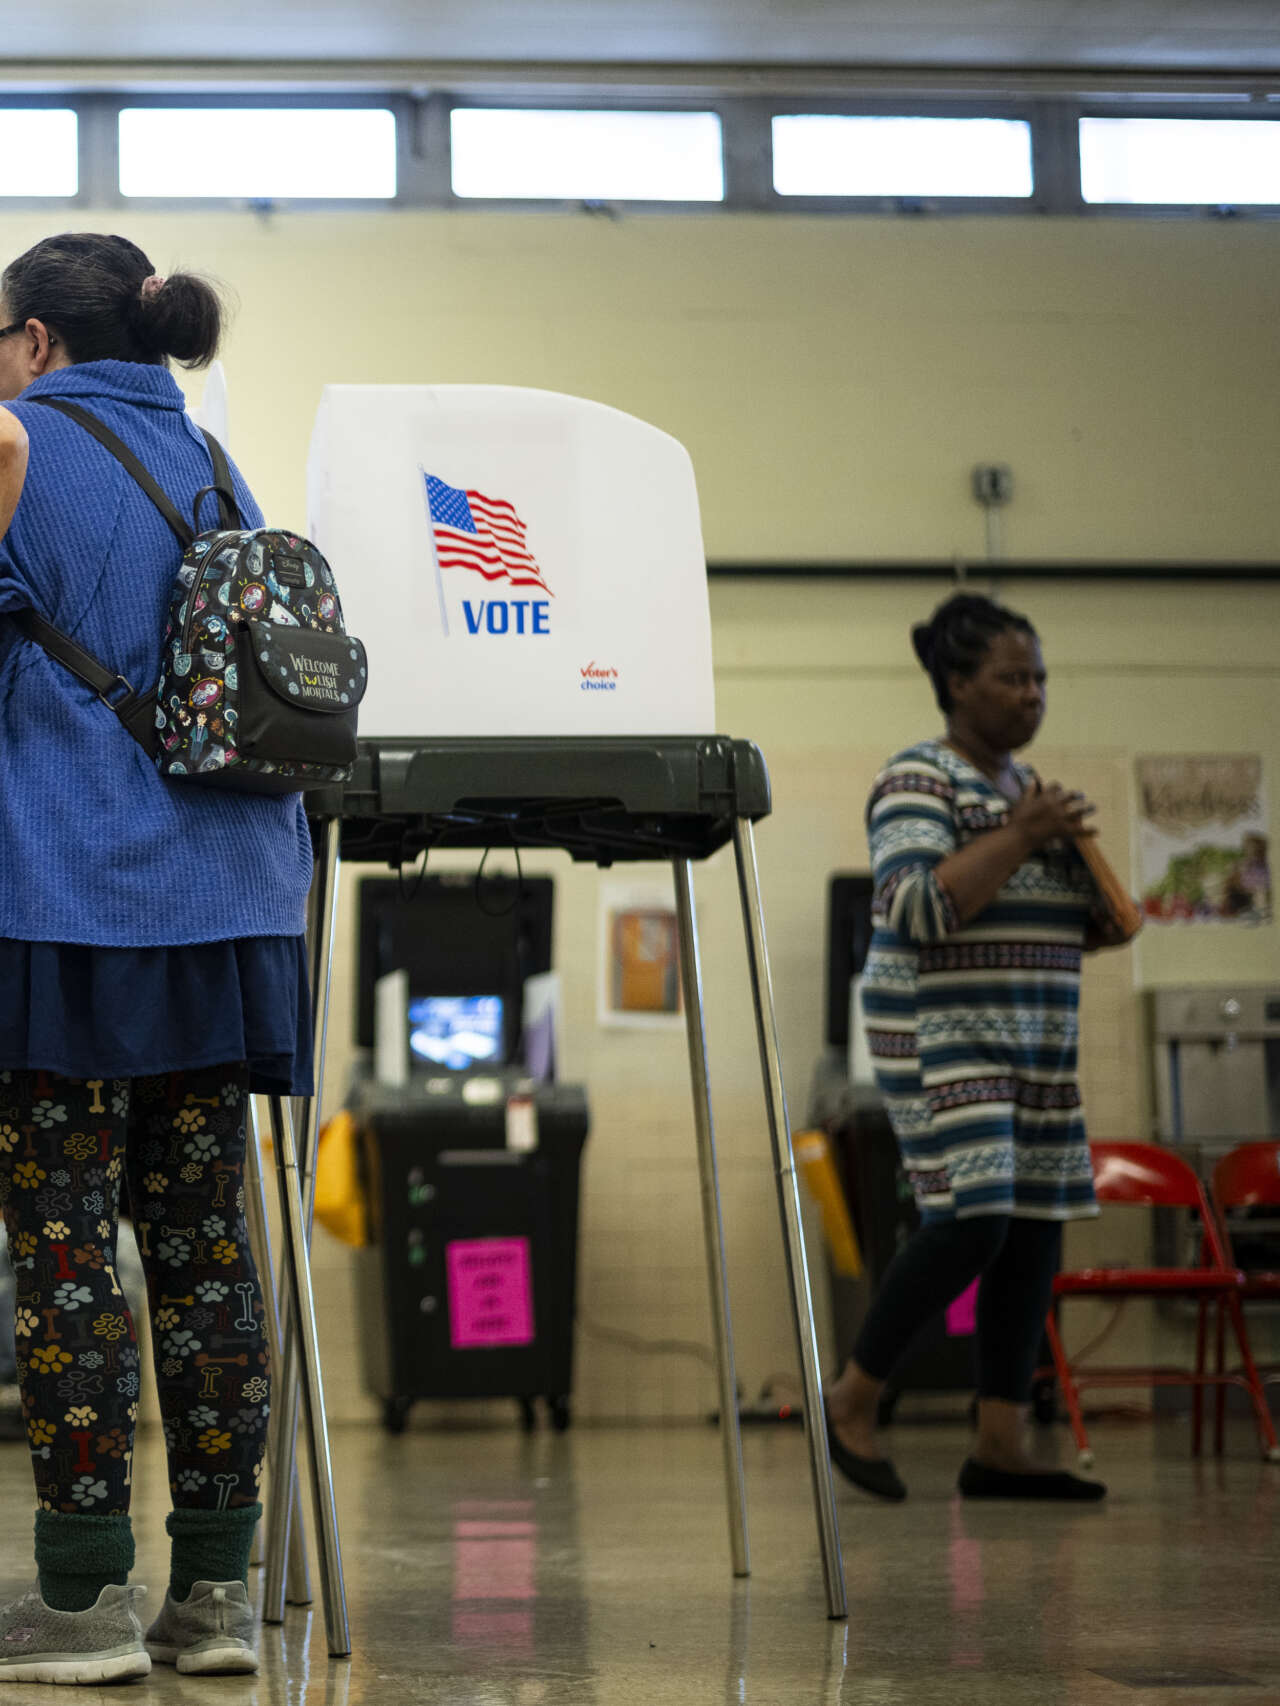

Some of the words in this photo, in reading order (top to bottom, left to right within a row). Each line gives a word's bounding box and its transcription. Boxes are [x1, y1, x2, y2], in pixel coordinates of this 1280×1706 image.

[462, 600, 550, 634] VOTE
[289, 653, 340, 676] WELCOME
[301, 686, 340, 702] MORTALS
[580, 679, 616, 691] choice
